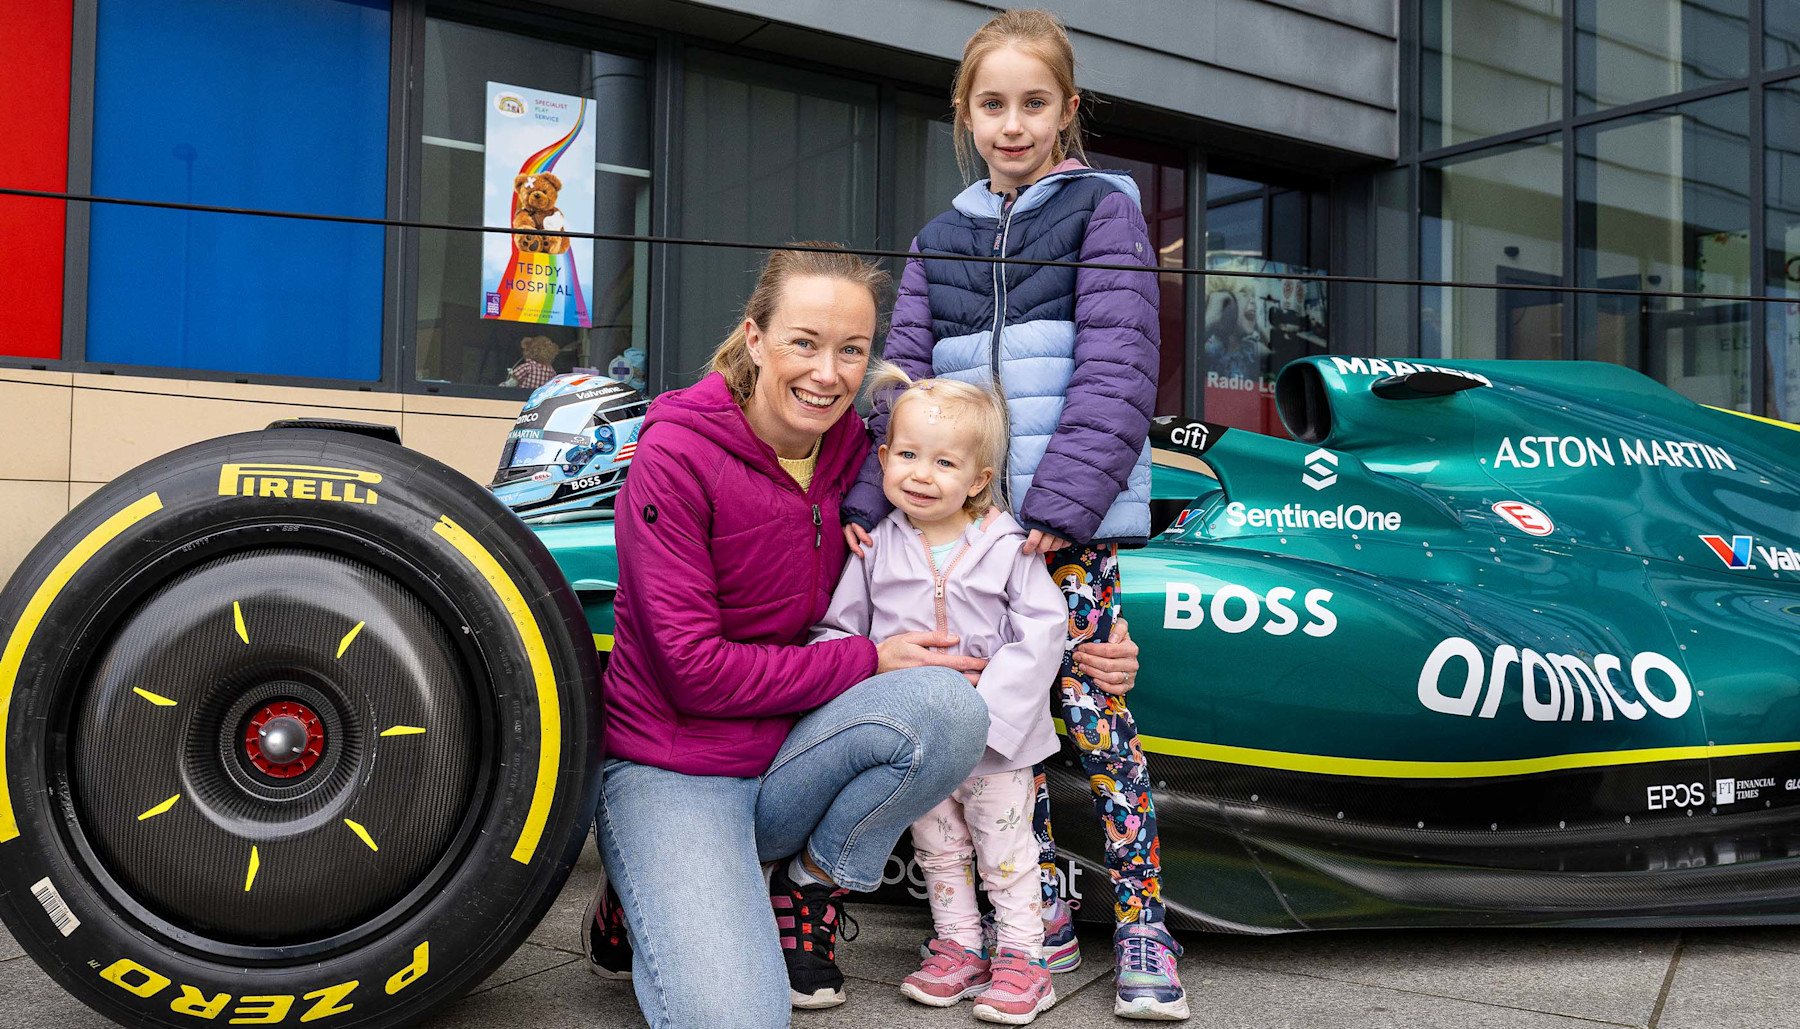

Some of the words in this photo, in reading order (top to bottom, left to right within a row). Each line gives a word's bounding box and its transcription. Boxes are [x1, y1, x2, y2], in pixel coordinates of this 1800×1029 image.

[535, 99, 568, 109] SPECIALIST
[534, 114, 559, 122] SERVICE
[518, 262, 562, 277] TEDDY
[505, 278, 572, 296] HOSPITAL
[1207, 371, 1254, 391] Radio
[576, 385, 623, 400] Valvoline
[1170, 423, 1209, 450] citi
[1493, 436, 1616, 468] ASTON
[1619, 438, 1737, 471] MARTIN
[218, 463, 383, 505] PIRELLI
[571, 475, 601, 490] BOSS
[1226, 502, 1402, 531] SentinelOne
[1501, 505, 1545, 530] E
[1163, 581, 1338, 638] BOSS
[1417, 636, 1692, 722] aramco
[1719, 782, 1733, 794] FT
[1736, 777, 1776, 790] FINANCIAL
[1736, 789, 1760, 800] TIMES
[1647, 782, 1706, 810] EPOS
[385, 941, 430, 995] P
[99, 958, 360, 1024] ZERO
